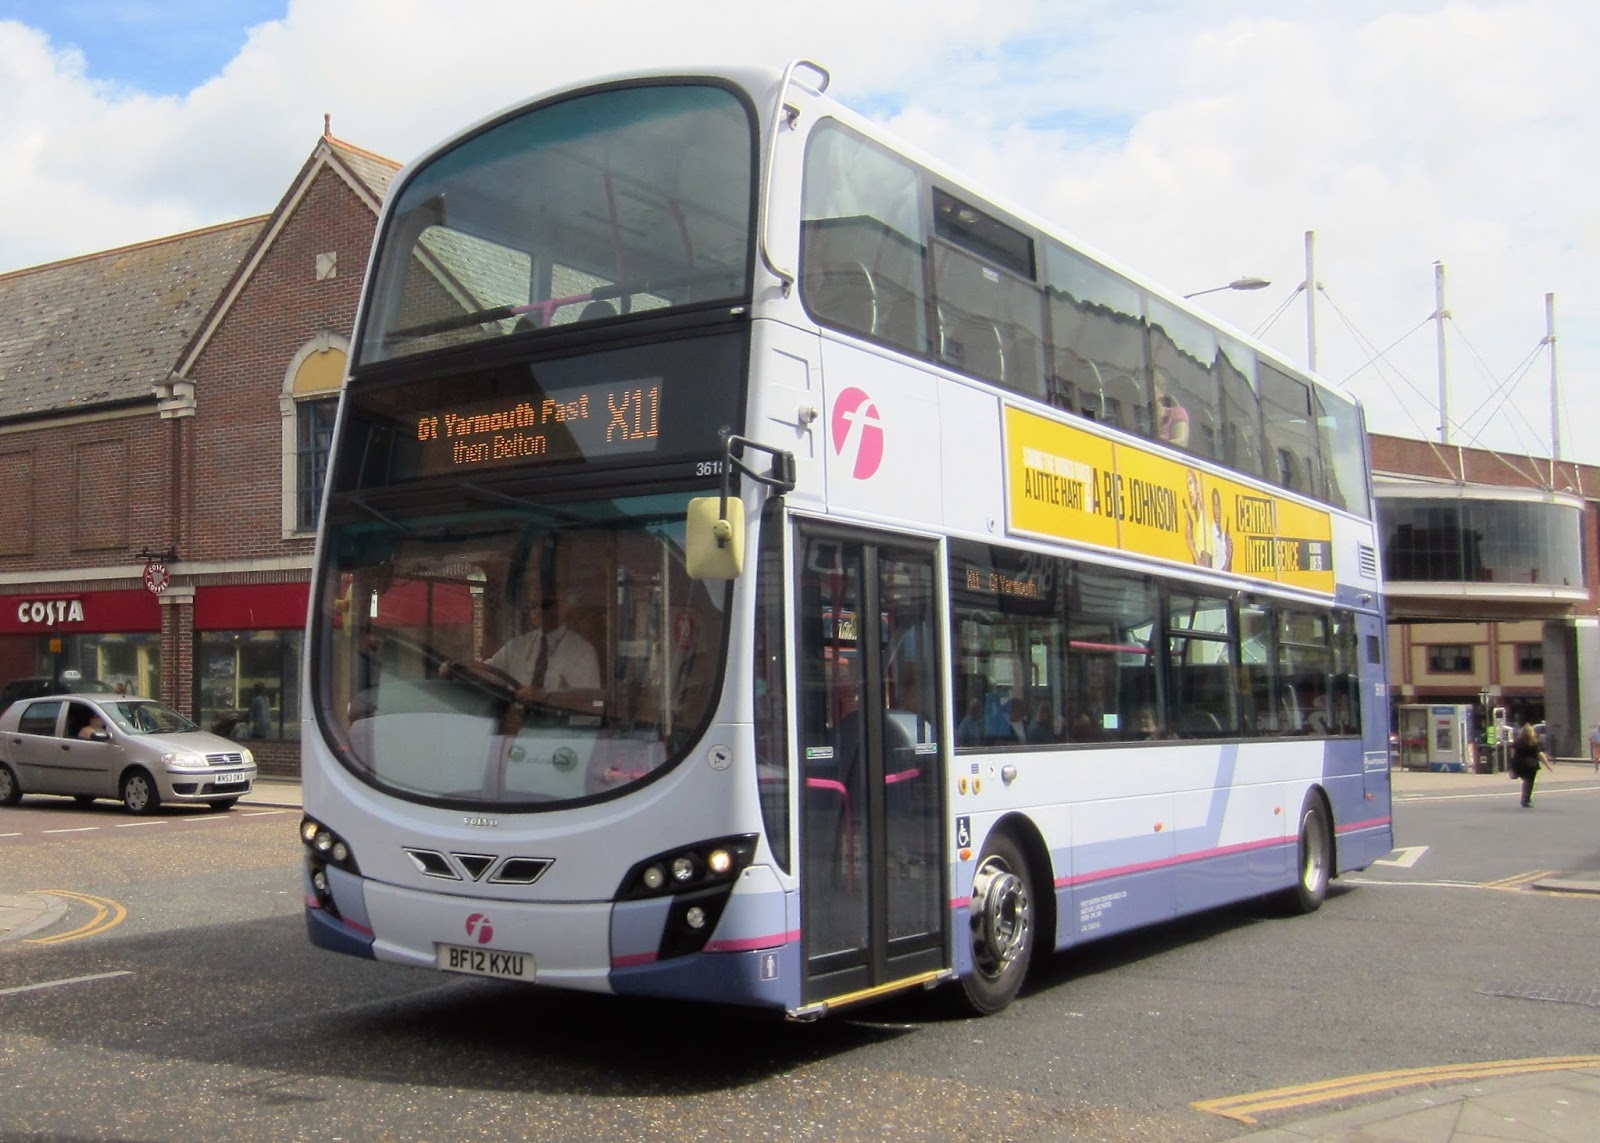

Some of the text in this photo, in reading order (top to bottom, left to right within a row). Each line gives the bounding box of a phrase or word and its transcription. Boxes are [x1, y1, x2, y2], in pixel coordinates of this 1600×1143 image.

[417, 394, 589, 441] Gt Yarmouth Fast
[606, 387, 659, 442] X11
[453, 432, 546, 464] then Belton
[1025, 467, 1032, 499] A
[1033, 469, 1060, 506] LITTLE
[1060, 477, 1082, 511] HART
[1093, 467, 1102, 516] A
[1103, 470, 1125, 521] BIG
[1129, 477, 1179, 534] JOHNSON
[1245, 535, 1300, 572] INTELLGENCE
[18, 600, 84, 626] COSTA
[463, 816, 498, 828] VOLVO
[449, 948, 524, 977] BF12 KXU
